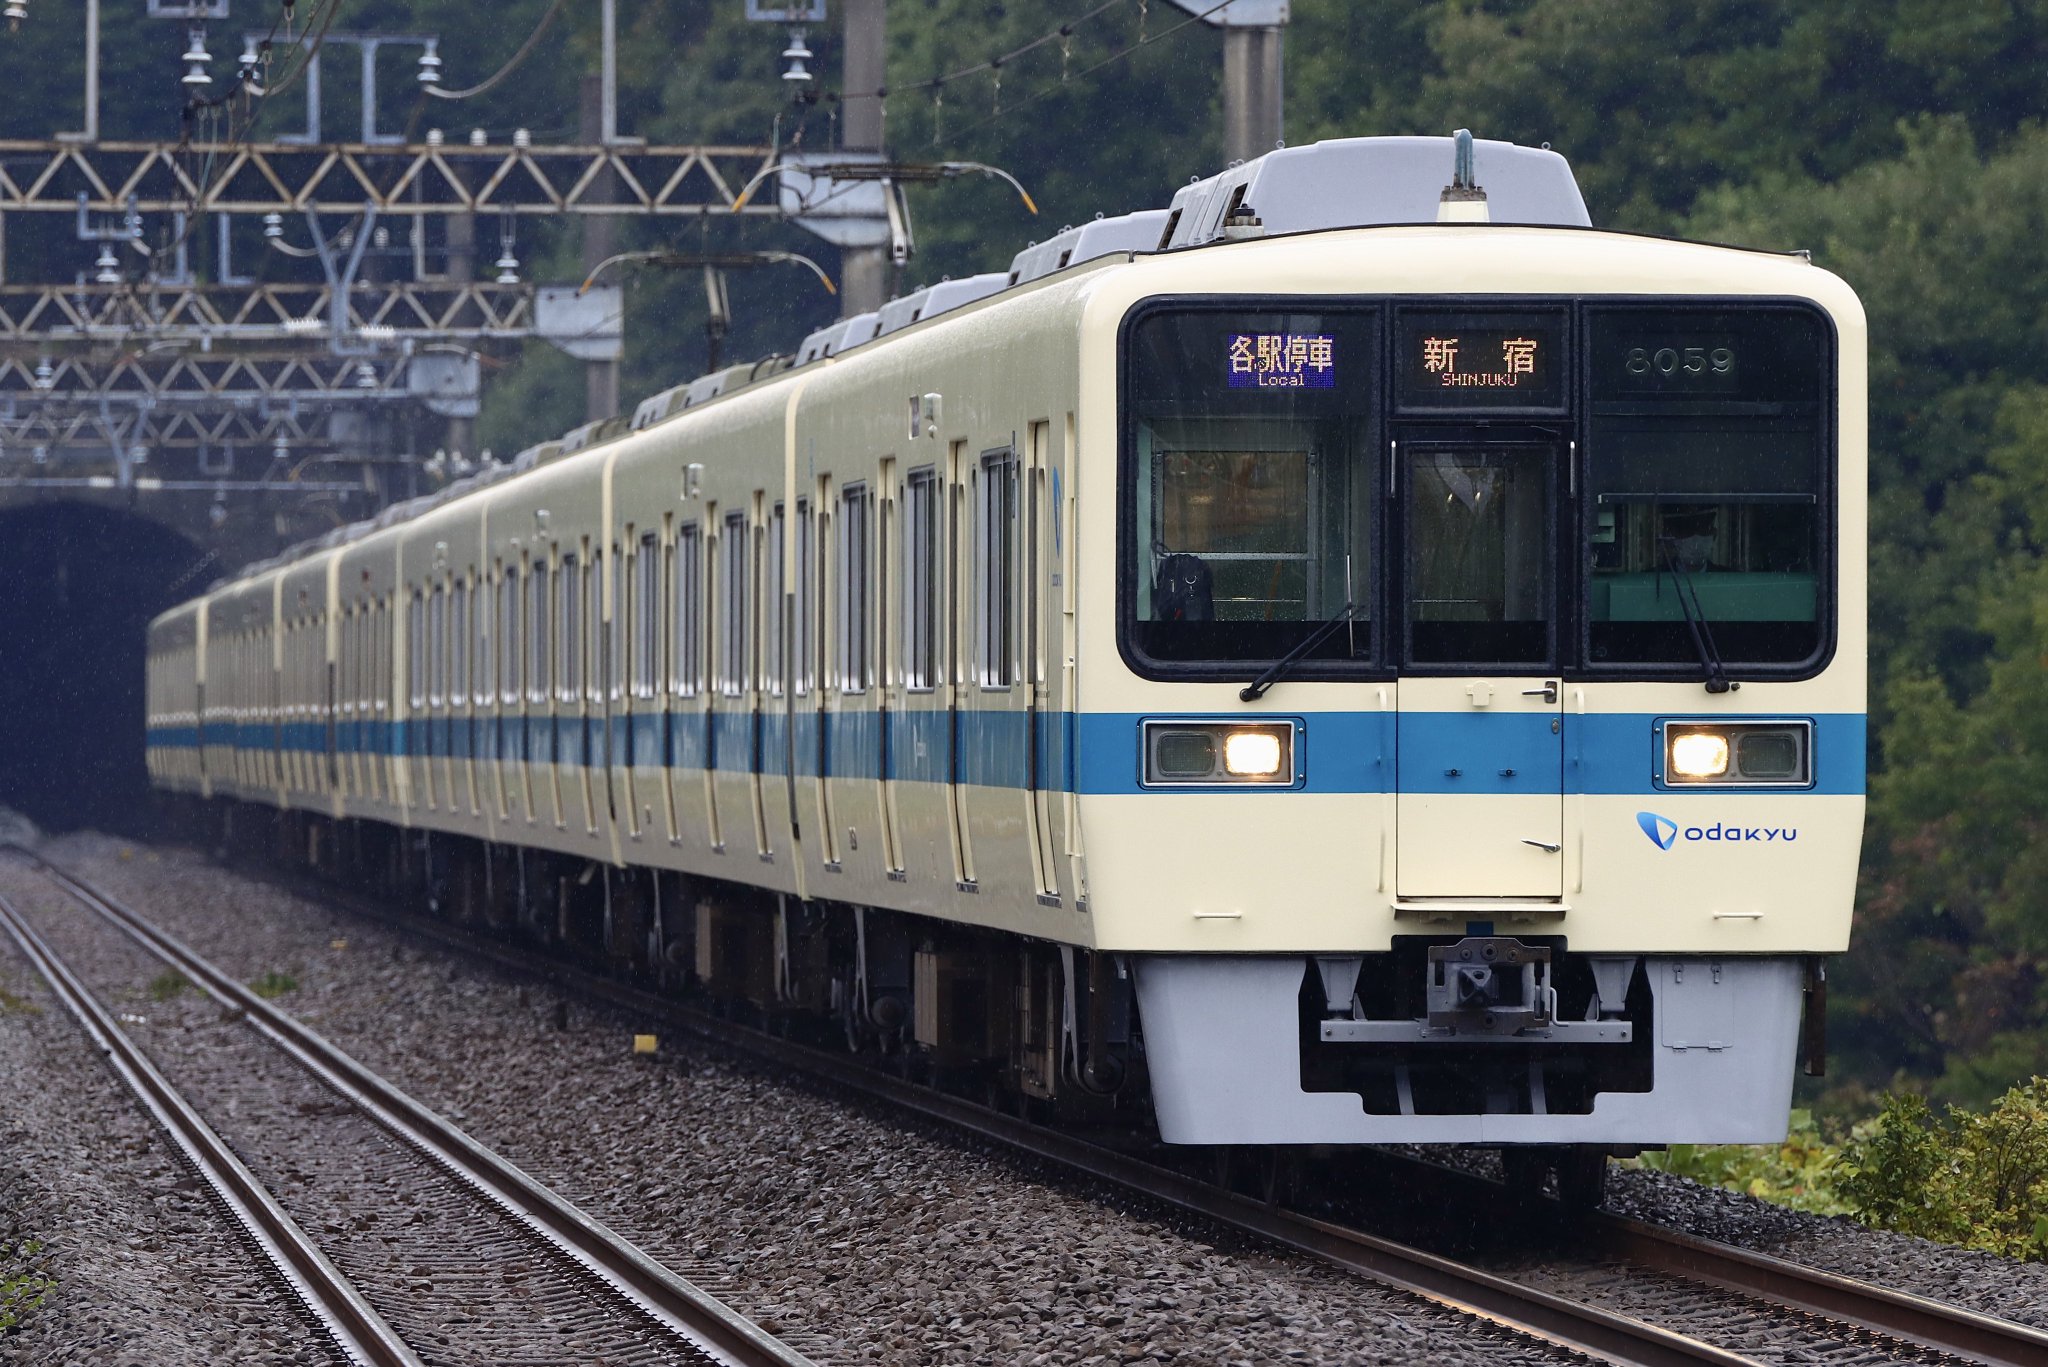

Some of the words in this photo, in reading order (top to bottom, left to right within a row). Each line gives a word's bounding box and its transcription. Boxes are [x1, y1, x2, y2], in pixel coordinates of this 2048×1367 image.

[1230, 335, 1333, 373] 各駅停車
[1625, 347, 1735, 376] 8059
[1258, 373, 1305, 386] Local
[1441, 373, 1517, 386] SHINJUKU
[1684, 822, 1797, 841] odakyu
